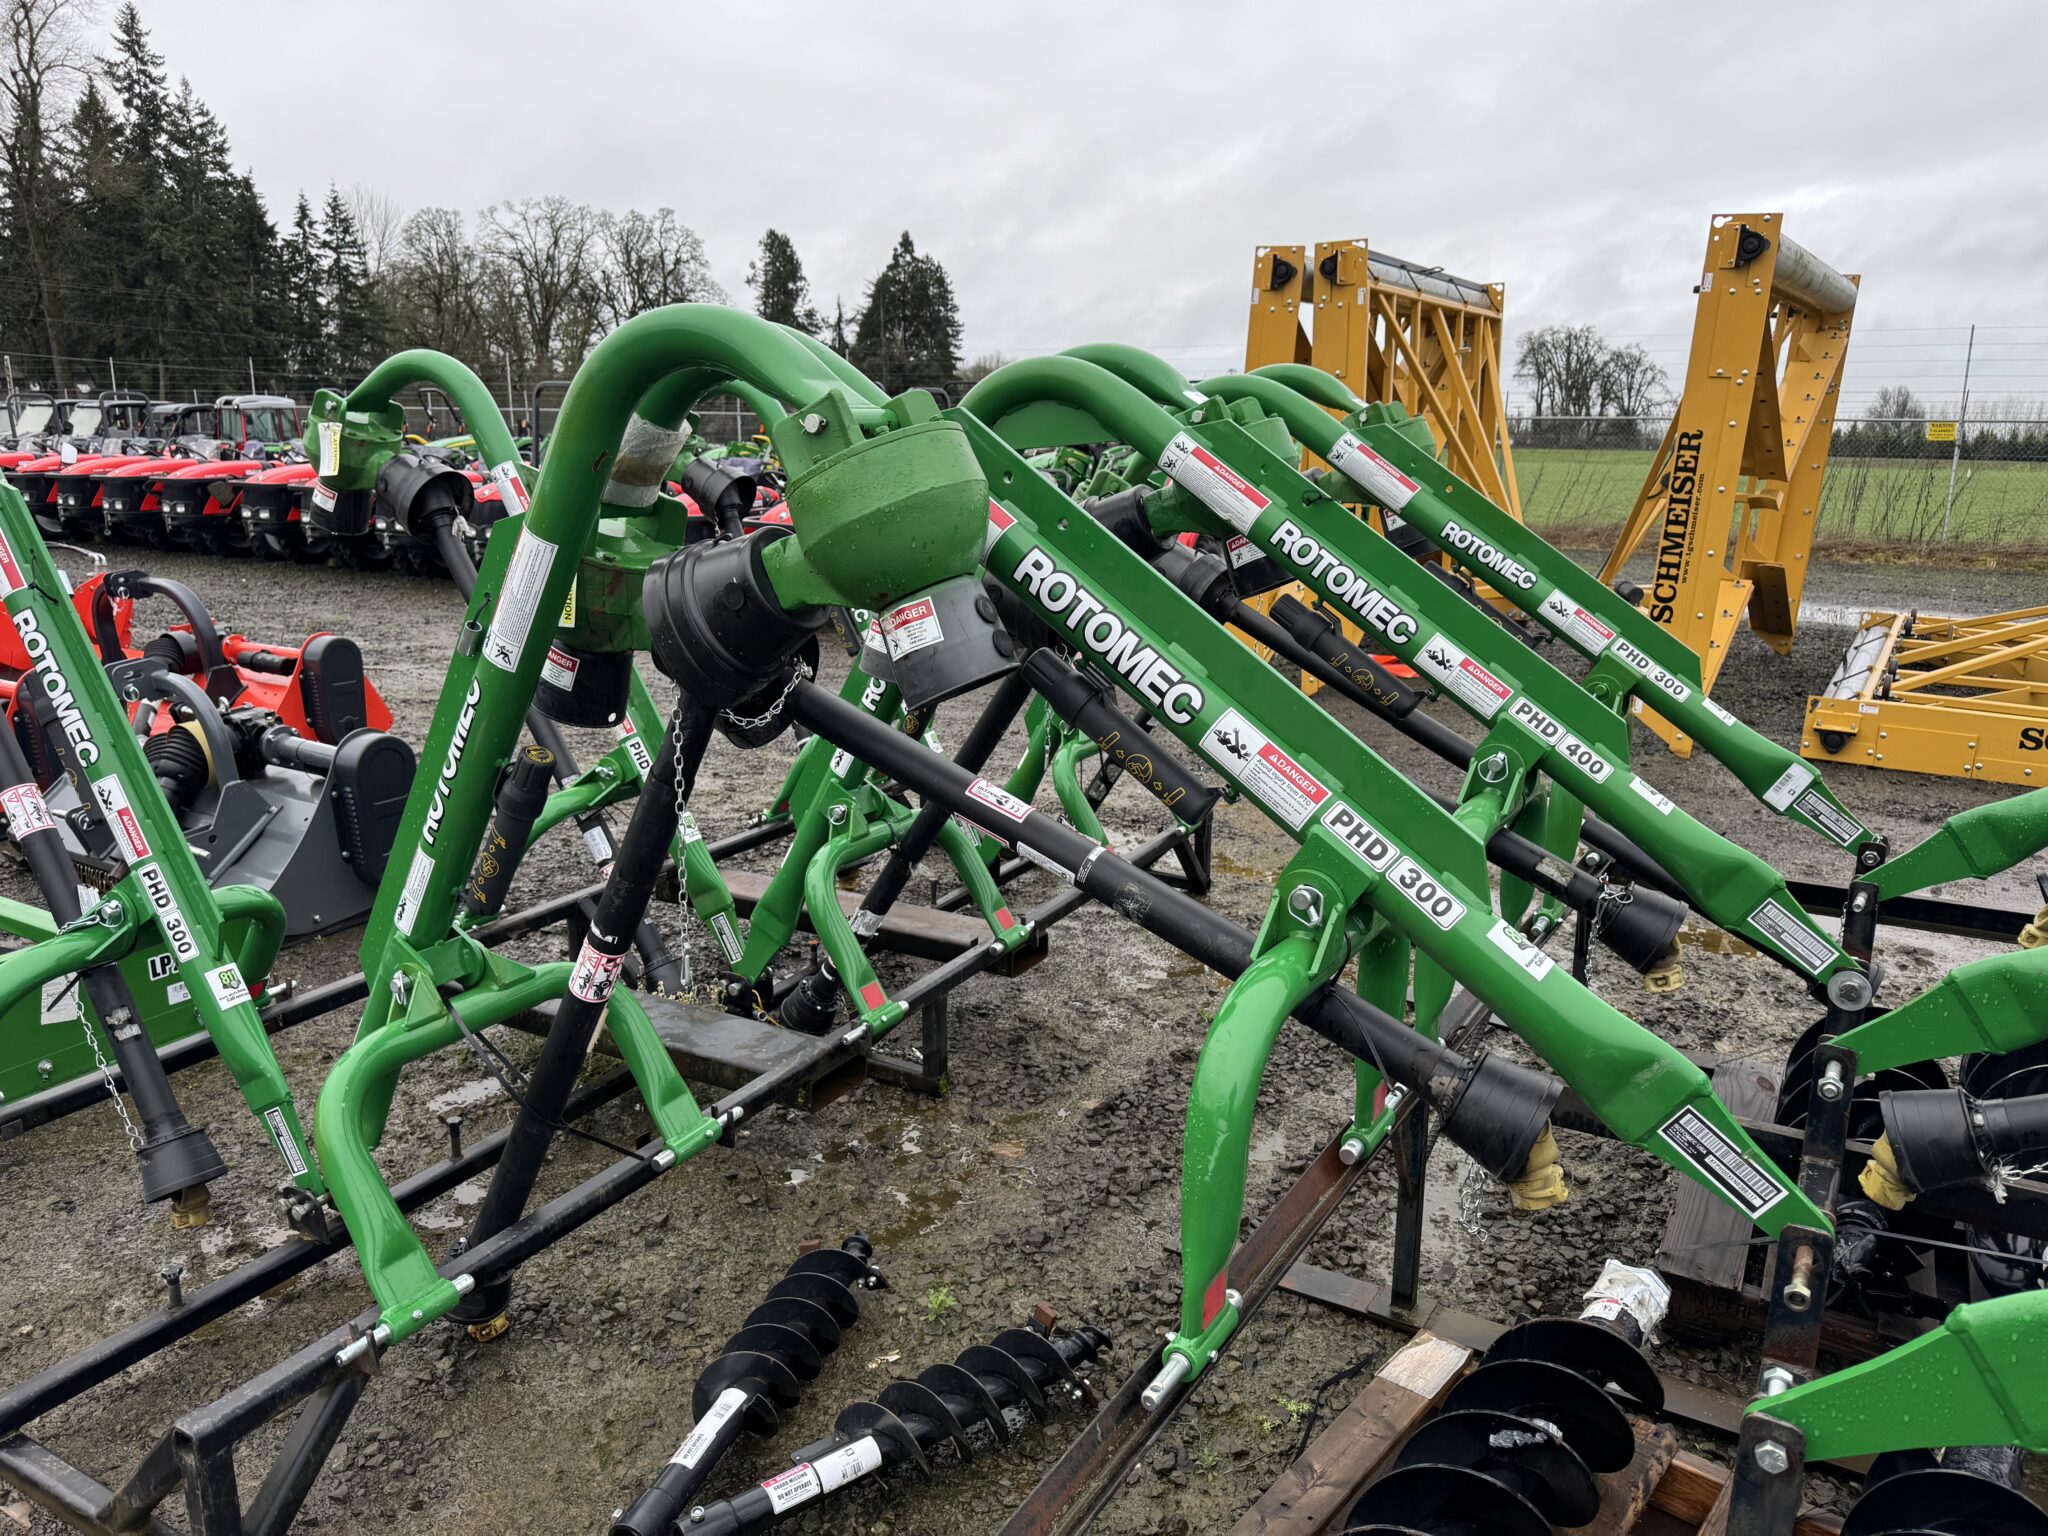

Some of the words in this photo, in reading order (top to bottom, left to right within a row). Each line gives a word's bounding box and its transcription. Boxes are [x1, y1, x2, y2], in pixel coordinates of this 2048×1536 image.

[1218, 469, 1245, 490] DANGER
[1378, 460, 1400, 478] DANGER
[1650, 429, 1704, 625] SCHMEISER
[1681, 473, 1705, 584] www.tgschmeiser.com
[1440, 520, 1538, 591] ROTOMEC
[1270, 520, 1419, 645] ROTOMEC
[889, 605, 927, 626] DANGER
[1583, 615, 1608, 635] DANGER
[1013, 549, 1206, 727] ROTOMEC
[547, 650, 573, 669] ANGER
[1616, 642, 1649, 670] PHD
[1654, 671, 1684, 696] 300
[13, 608, 98, 767] ROTOMEC
[1472, 667, 1503, 693] DANGER
[630, 741, 651, 771] PHD
[1515, 702, 1558, 739] PHD
[1565, 743, 1604, 775] 400
[1256, 757, 1273, 773] Avoid
[1270, 770, 1287, 787] injury
[1285, 783, 1299, 796] from
[1298, 793, 1311, 806] PTO
[1276, 759, 1317, 794] DANGER
[125, 821, 144, 852] DANGER
[1330, 808, 1389, 861] PHD
[1399, 868, 1453, 917] 300
[143, 868, 171, 909] PHD
[166, 918, 192, 954] 300
[1672, 1122, 1697, 1145] ROTOMEC
[1695, 1143, 1707, 1154] USA
[772, 1479, 789, 1490] GUARD
[788, 1471, 807, 1483] MISSING
[777, 1492, 784, 1500] DO
[784, 1488, 793, 1497] NOT
[793, 1479, 812, 1492] OPERATE
